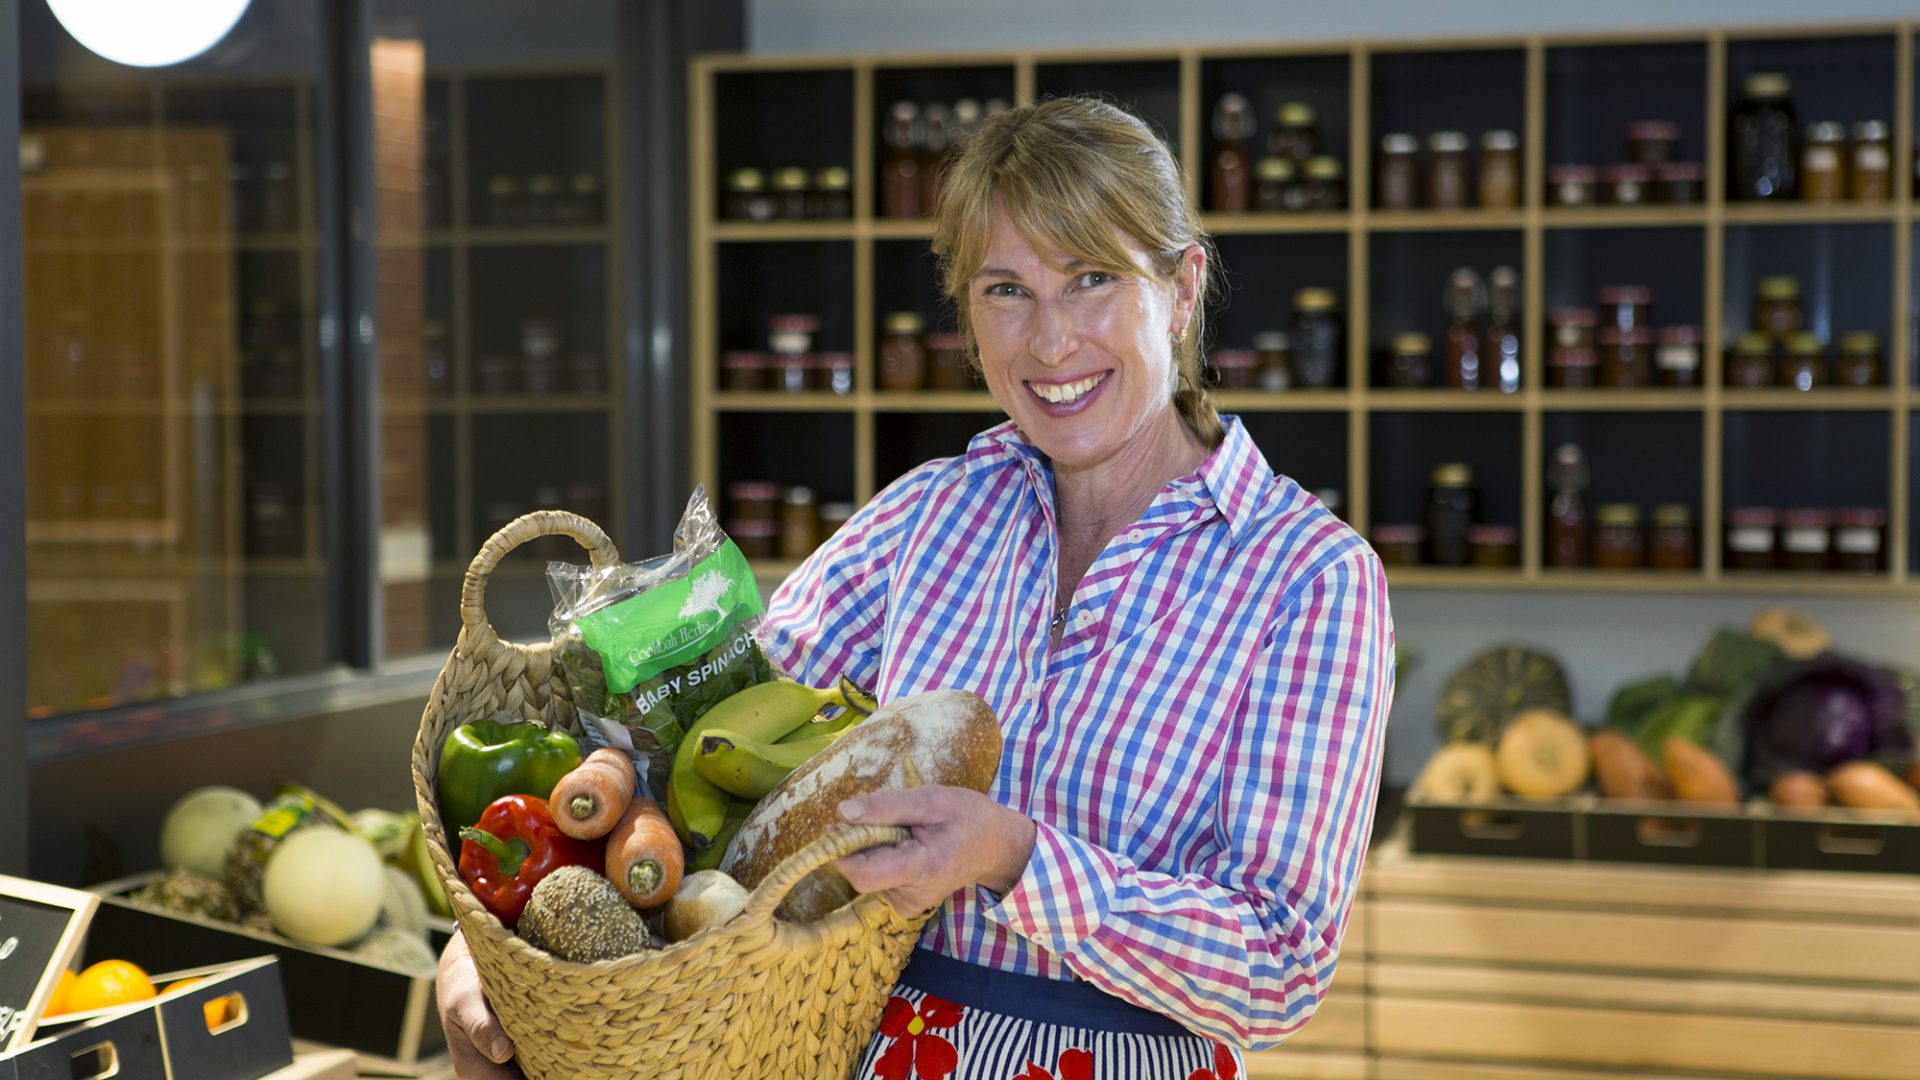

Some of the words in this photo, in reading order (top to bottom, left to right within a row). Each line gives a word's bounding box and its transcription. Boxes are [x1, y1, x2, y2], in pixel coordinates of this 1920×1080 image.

[628, 632, 677, 664] Coolibah
[680, 620, 710, 643] Herbs
[635, 676, 681, 715] BABY
[687, 629, 758, 687] SPINACH
